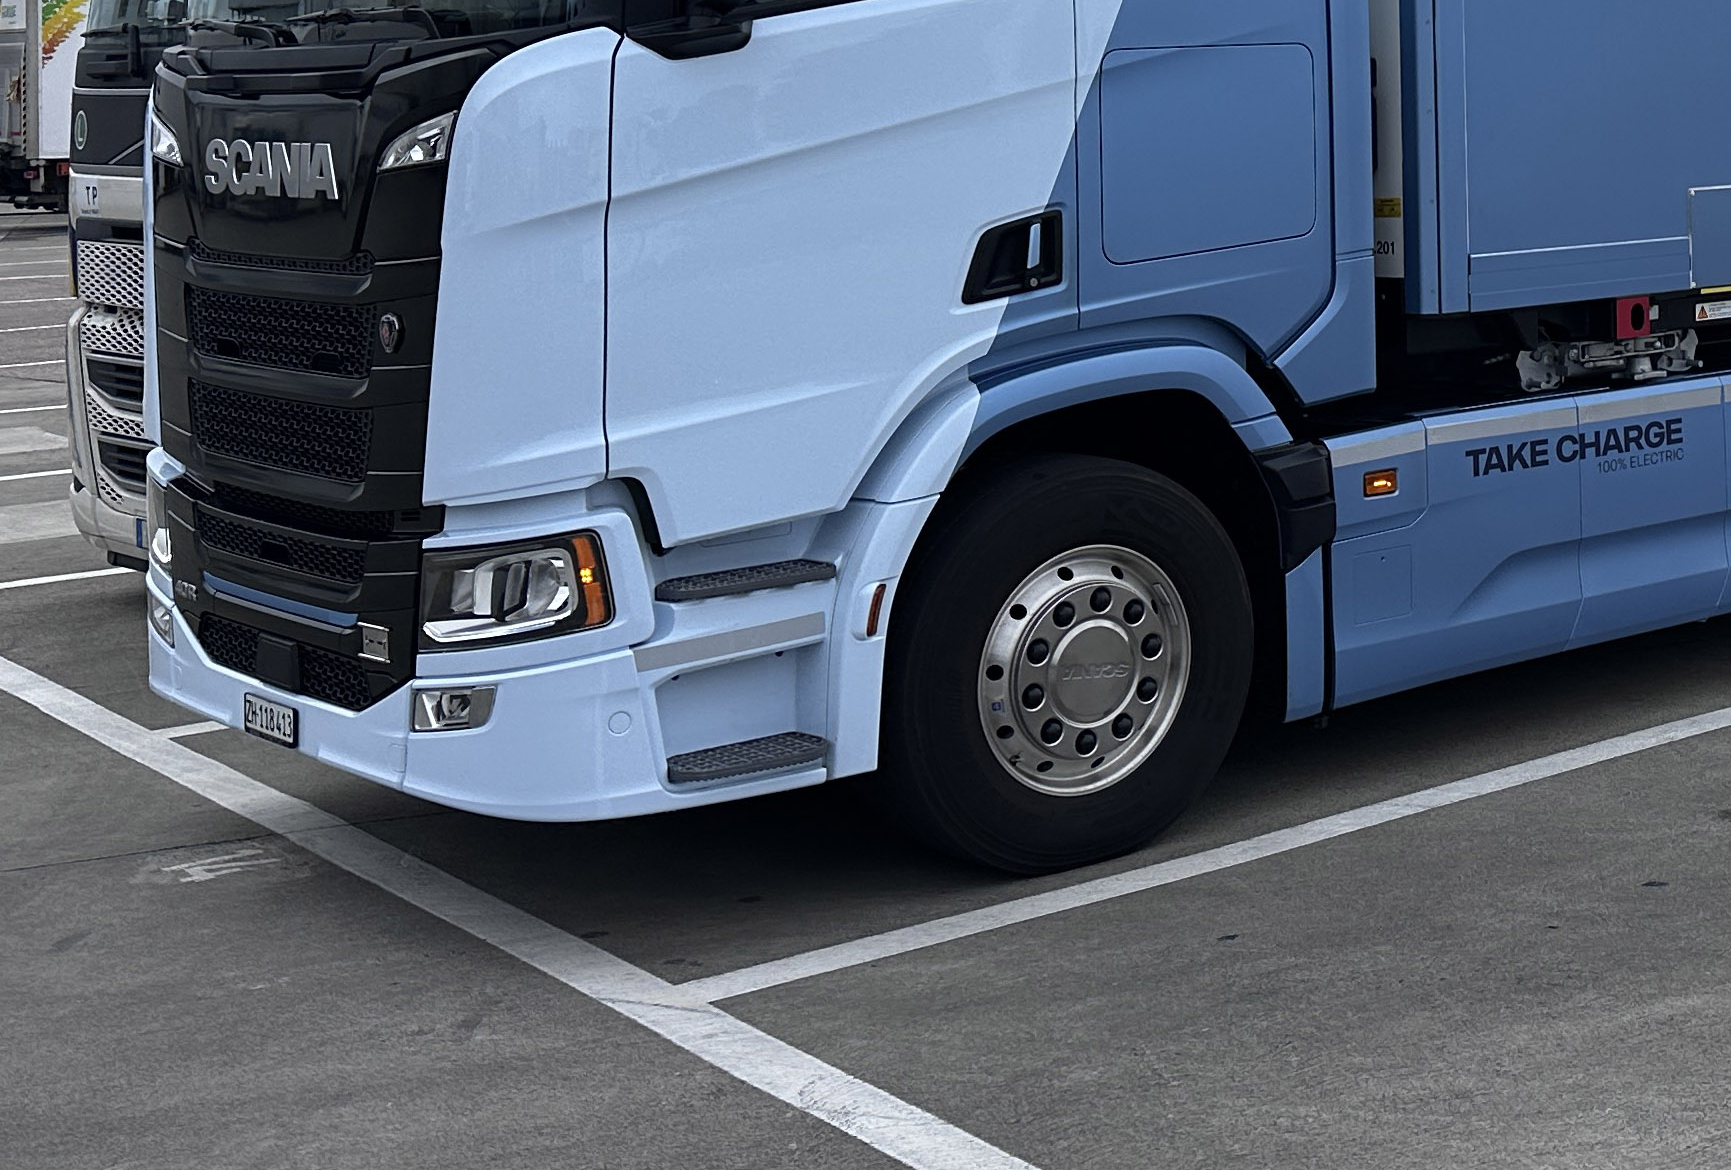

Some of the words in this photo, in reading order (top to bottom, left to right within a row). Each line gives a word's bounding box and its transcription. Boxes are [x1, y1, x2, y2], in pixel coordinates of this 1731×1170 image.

[204, 138, 339, 200] SCANIA
[1465, 438, 1549, 478] TAKE
[1556, 417, 1684, 462] CHARGE
[1597, 458, 1628, 473] 100%
[1629, 447, 1685, 469] ELECTRIC
